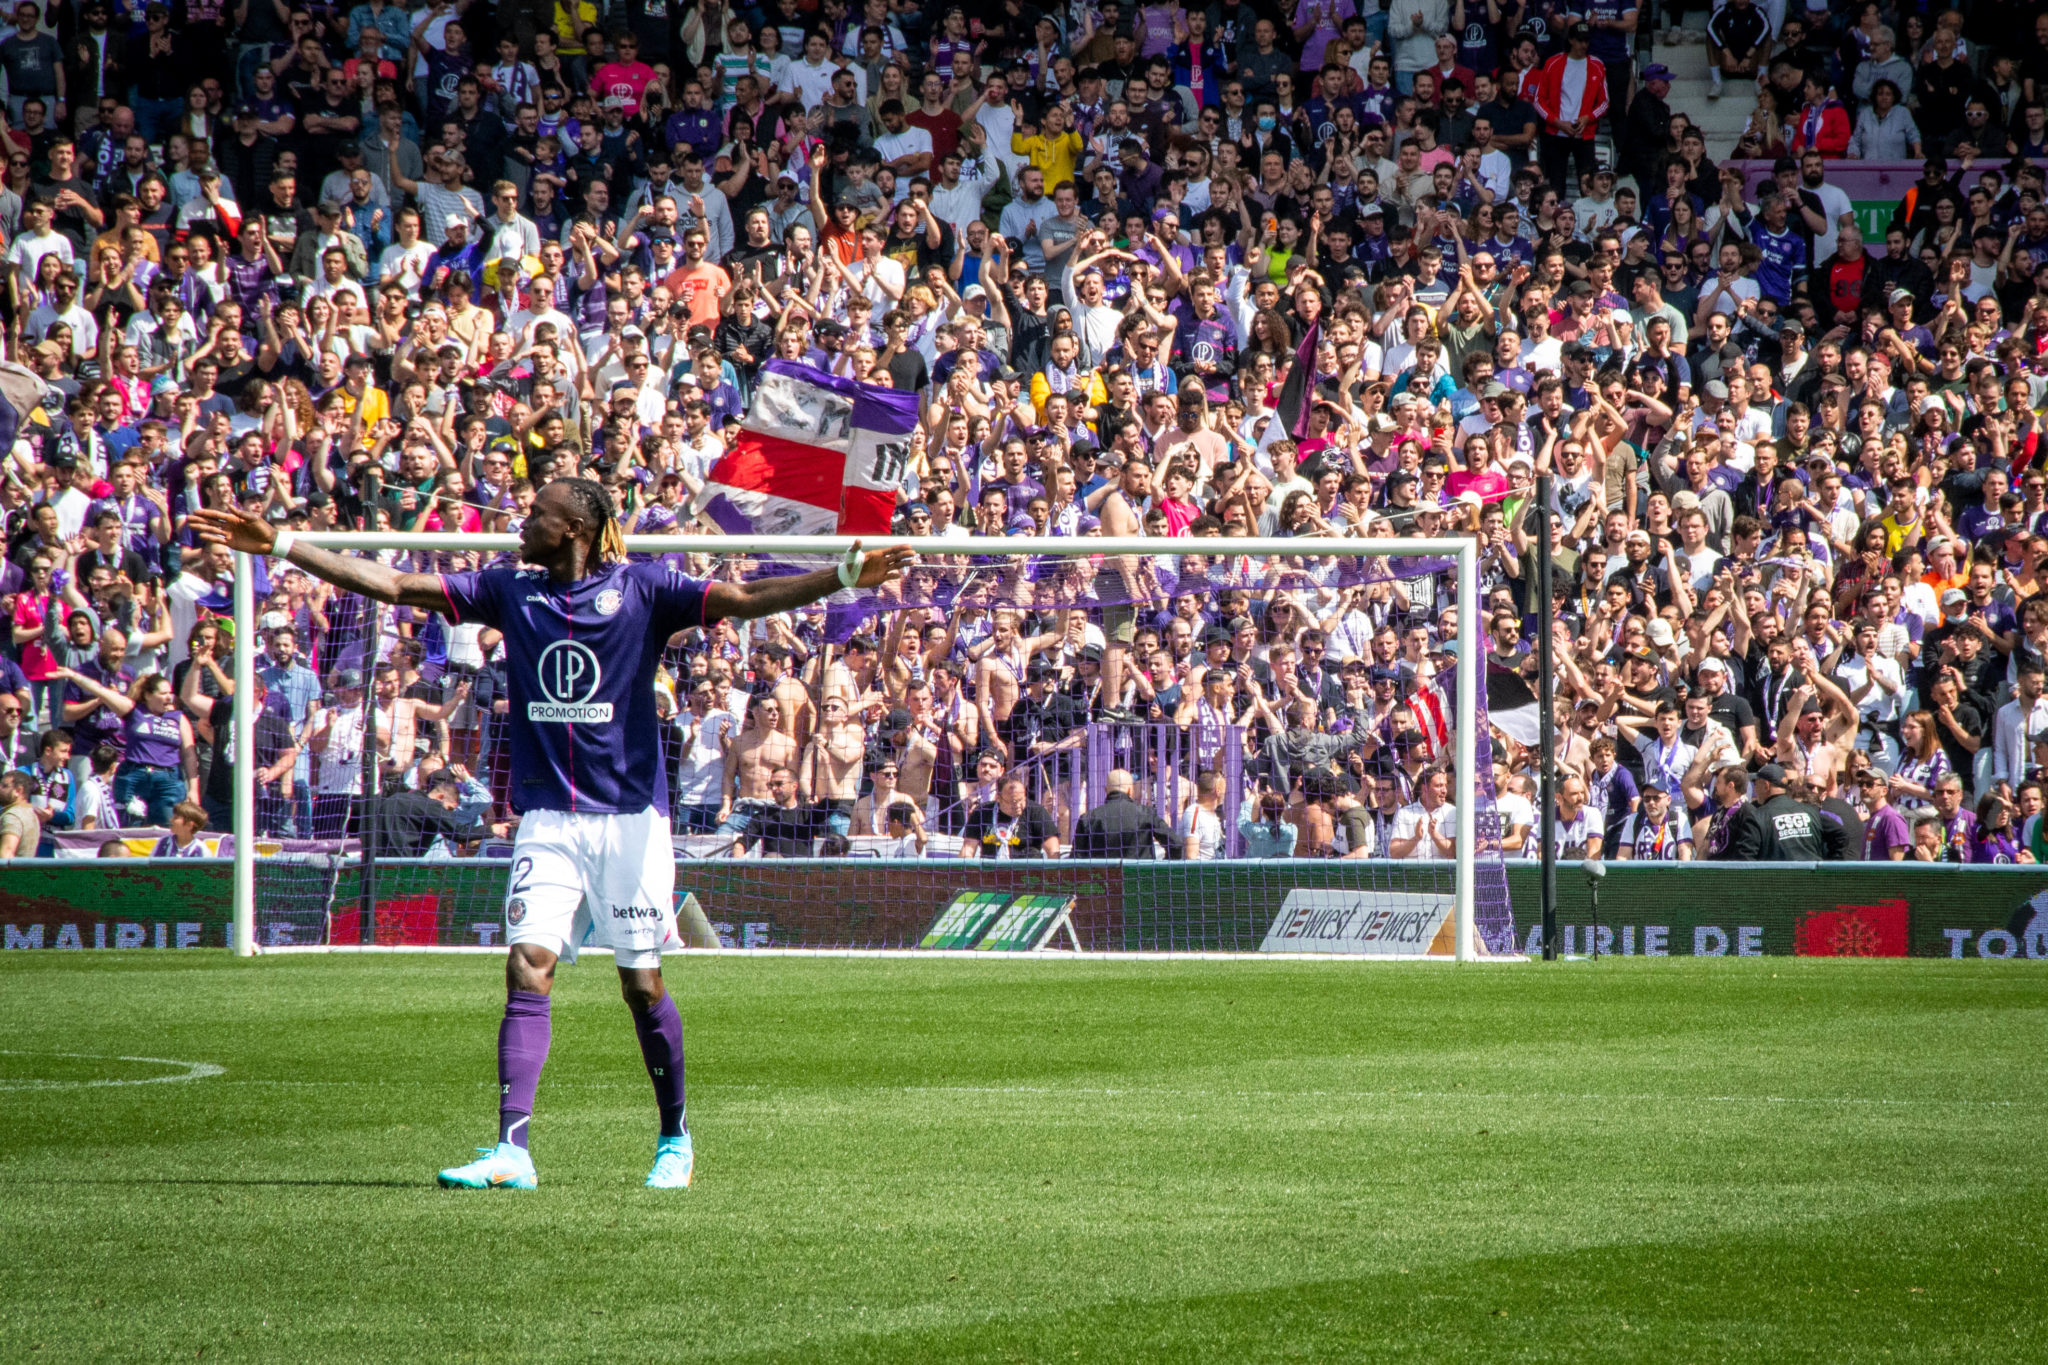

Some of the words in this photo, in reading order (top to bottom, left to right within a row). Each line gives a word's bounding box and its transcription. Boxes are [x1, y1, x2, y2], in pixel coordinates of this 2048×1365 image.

[680, 218, 713, 228] adids
[531, 706, 609, 719] PROMOTION
[1775, 814, 1811, 831] CSGP
[612, 904, 663, 922] betway
[929, 903, 1002, 938] BKT
[985, 906, 1057, 942] BKT
[4, 922, 201, 949] MAIRIE
[1694, 926, 1763, 957] DE
[653, 1067, 665, 1076] 12
